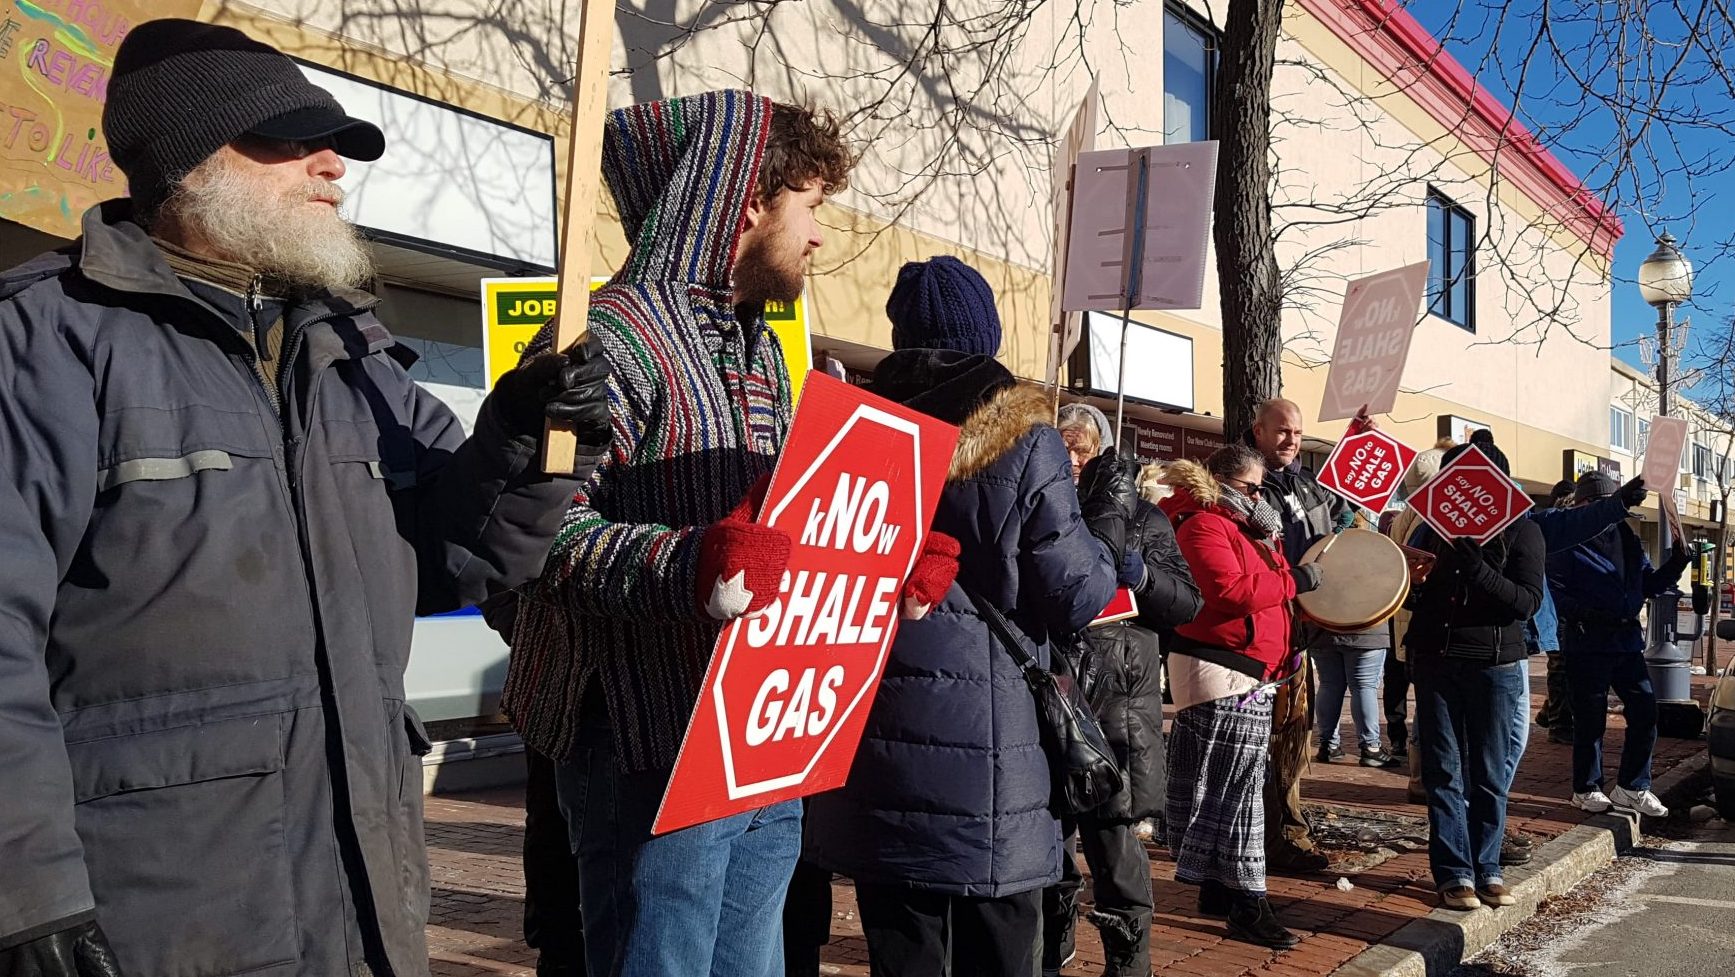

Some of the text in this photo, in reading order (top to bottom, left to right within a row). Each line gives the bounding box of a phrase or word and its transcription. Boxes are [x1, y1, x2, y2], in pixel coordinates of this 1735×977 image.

[4, 105, 115, 184] TO LIKE
[1344, 441, 1374, 485] say NO to
[1354, 446, 1386, 490] SHALE
[1370, 461, 1392, 489] GAS
[1439, 501, 1468, 528] GAS
[1443, 484, 1488, 526] SHALE
[1455, 475, 1498, 515] say NO to
[746, 568, 899, 648] SHALE
[745, 664, 845, 747] GAS
